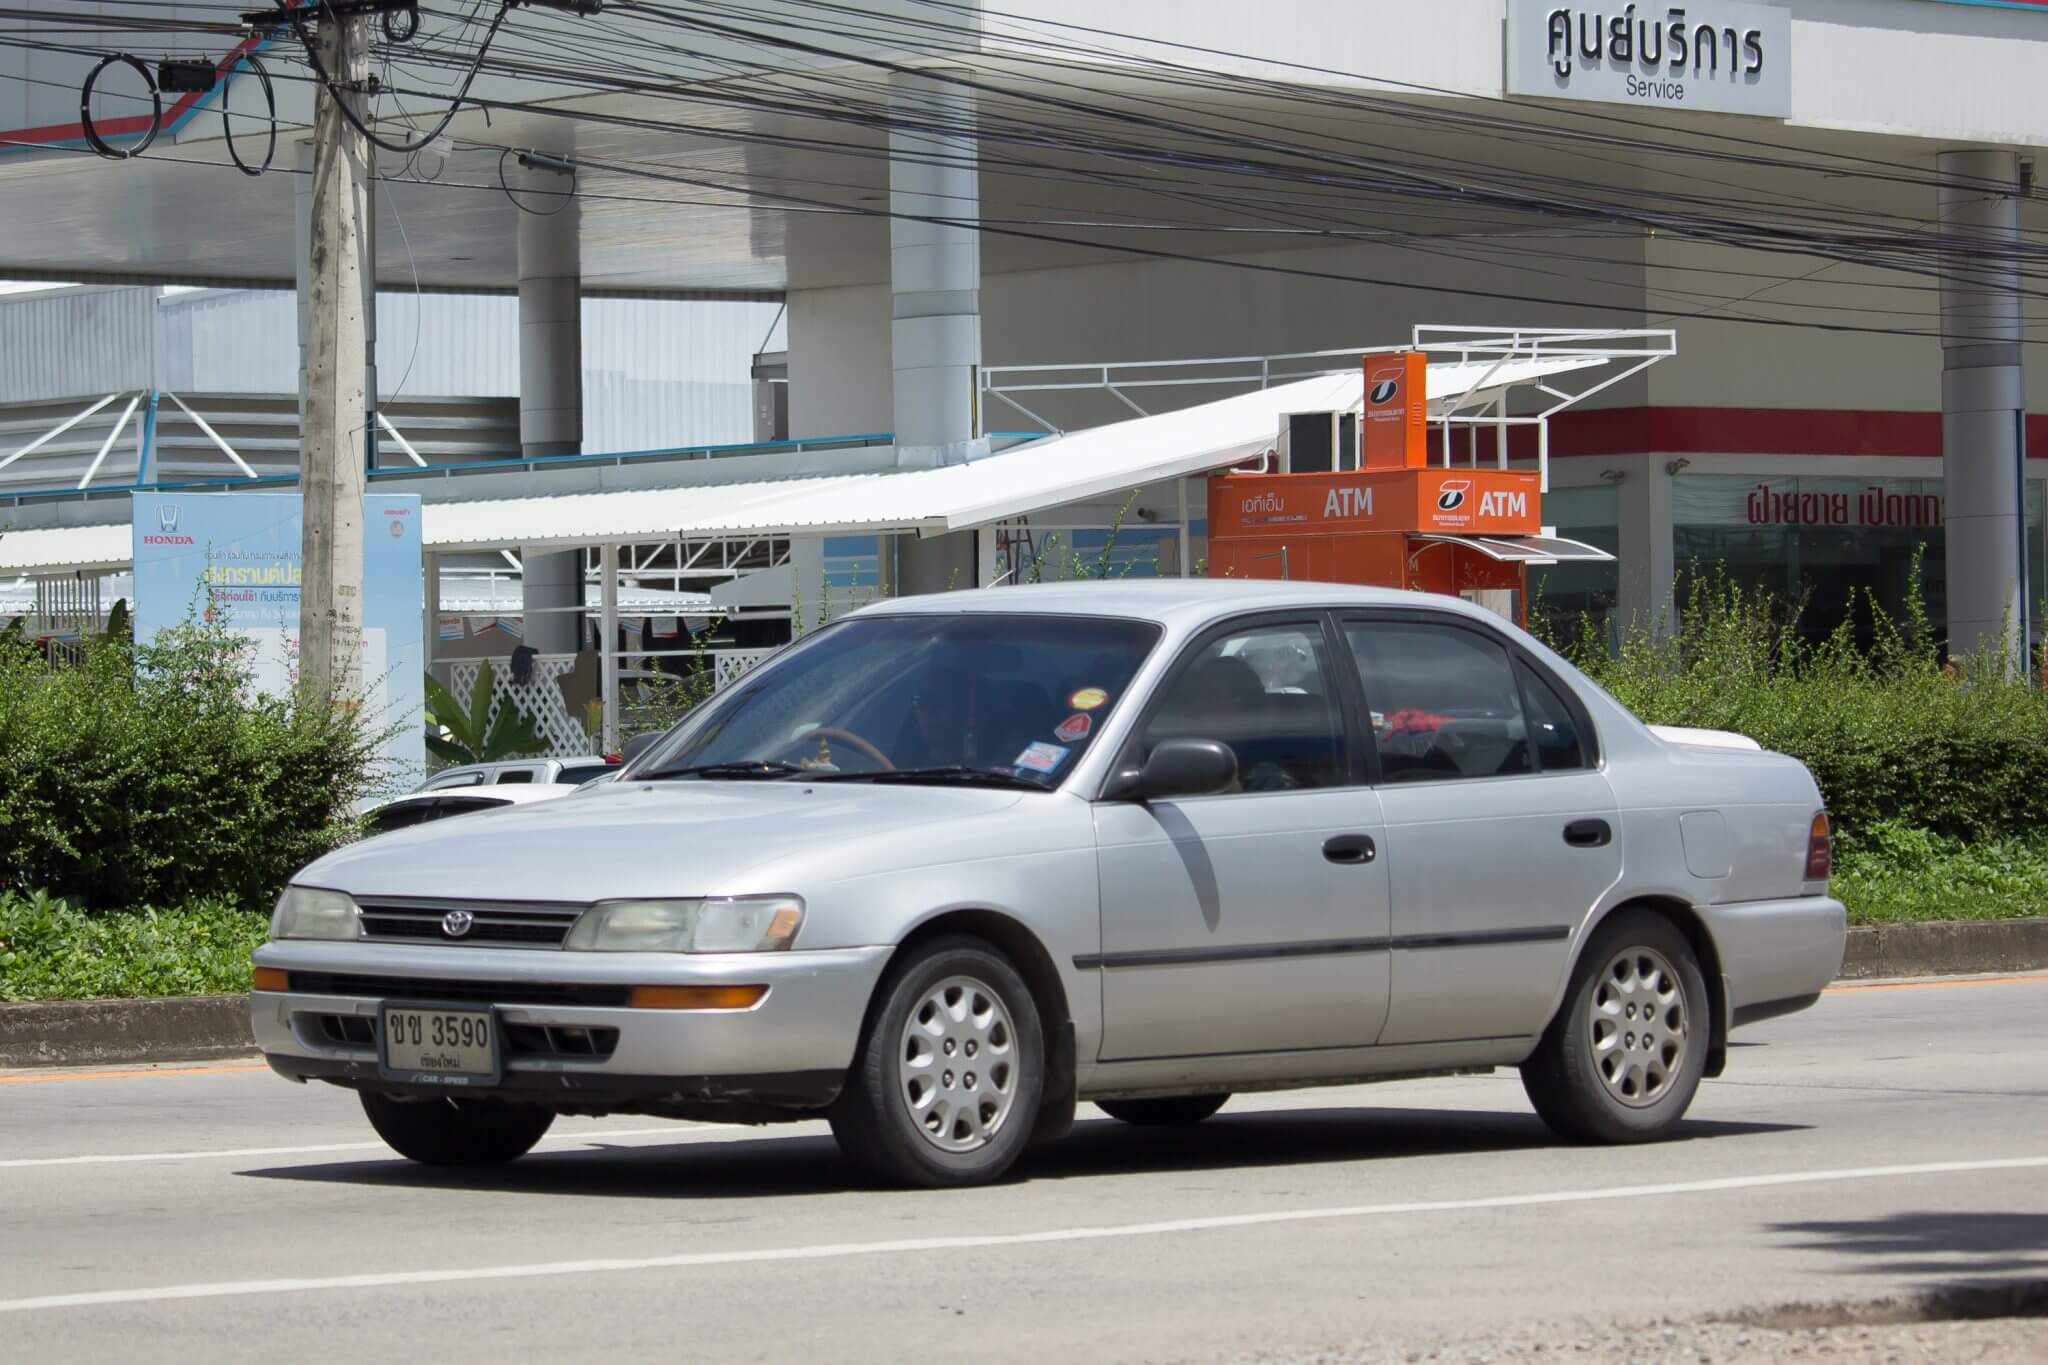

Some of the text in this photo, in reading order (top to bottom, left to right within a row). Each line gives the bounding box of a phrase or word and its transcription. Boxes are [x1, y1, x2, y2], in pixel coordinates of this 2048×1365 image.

[1547, 3, 1763, 79] ศูนย์บริการ
[1626, 75, 1684, 100] Service
[1323, 487, 1373, 518] ATM
[1479, 491, 1526, 517] ATM
[143, 535, 194, 545] HONDA
[432, 1015, 488, 1048] 3590
